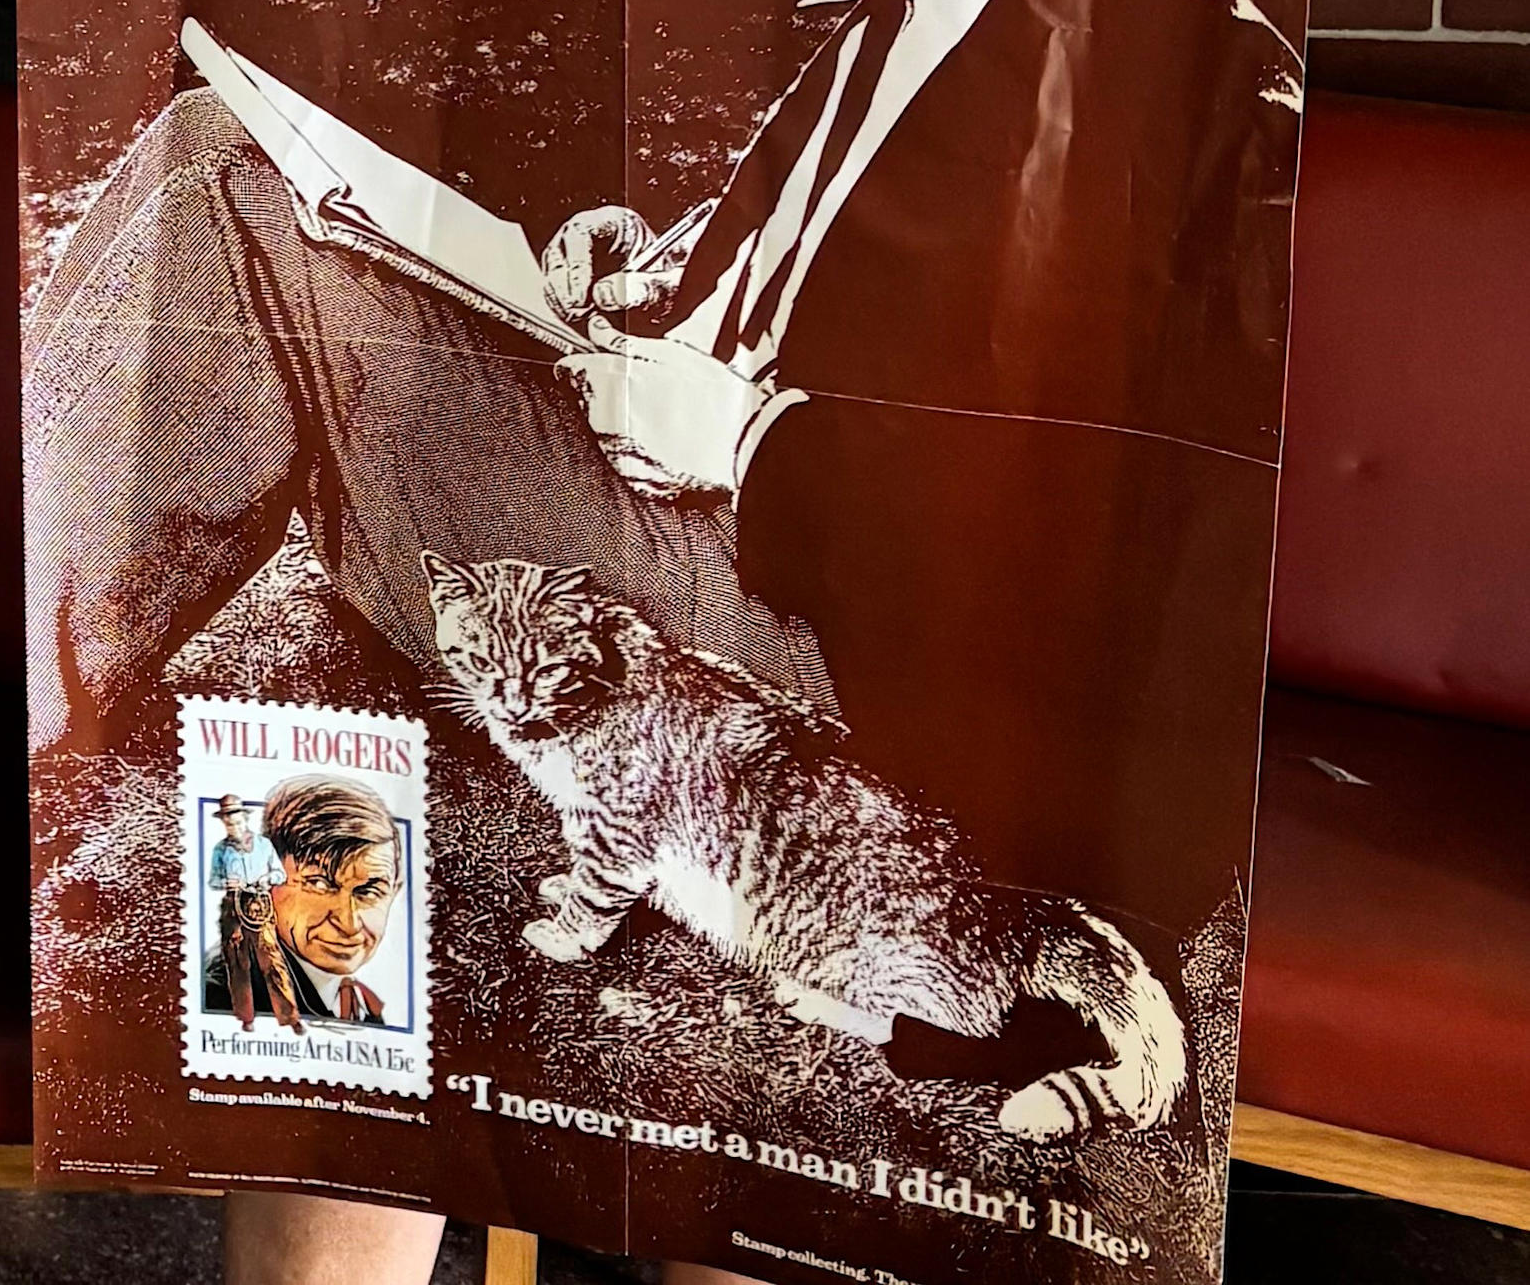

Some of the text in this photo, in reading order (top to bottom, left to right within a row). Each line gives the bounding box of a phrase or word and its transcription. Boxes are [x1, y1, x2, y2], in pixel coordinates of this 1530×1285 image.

[198, 718, 413, 778] WILL ROGERS
[201, 1029, 301, 1063] Performing
[303, 1035, 345, 1063] Arts
[345, 1040, 385, 1071] USA
[188, 1086, 431, 1126] Stamp available after November 4.
[498, 1090, 624, 1138] never
[627, 1116, 720, 1154] met
[723, 1132, 754, 1162] a
[756, 1139, 862, 1191] man
[870, 1158, 893, 1199] I
[731, 1230, 787, 1260] Stamp
[787, 1249, 872, 1283] collecting.
